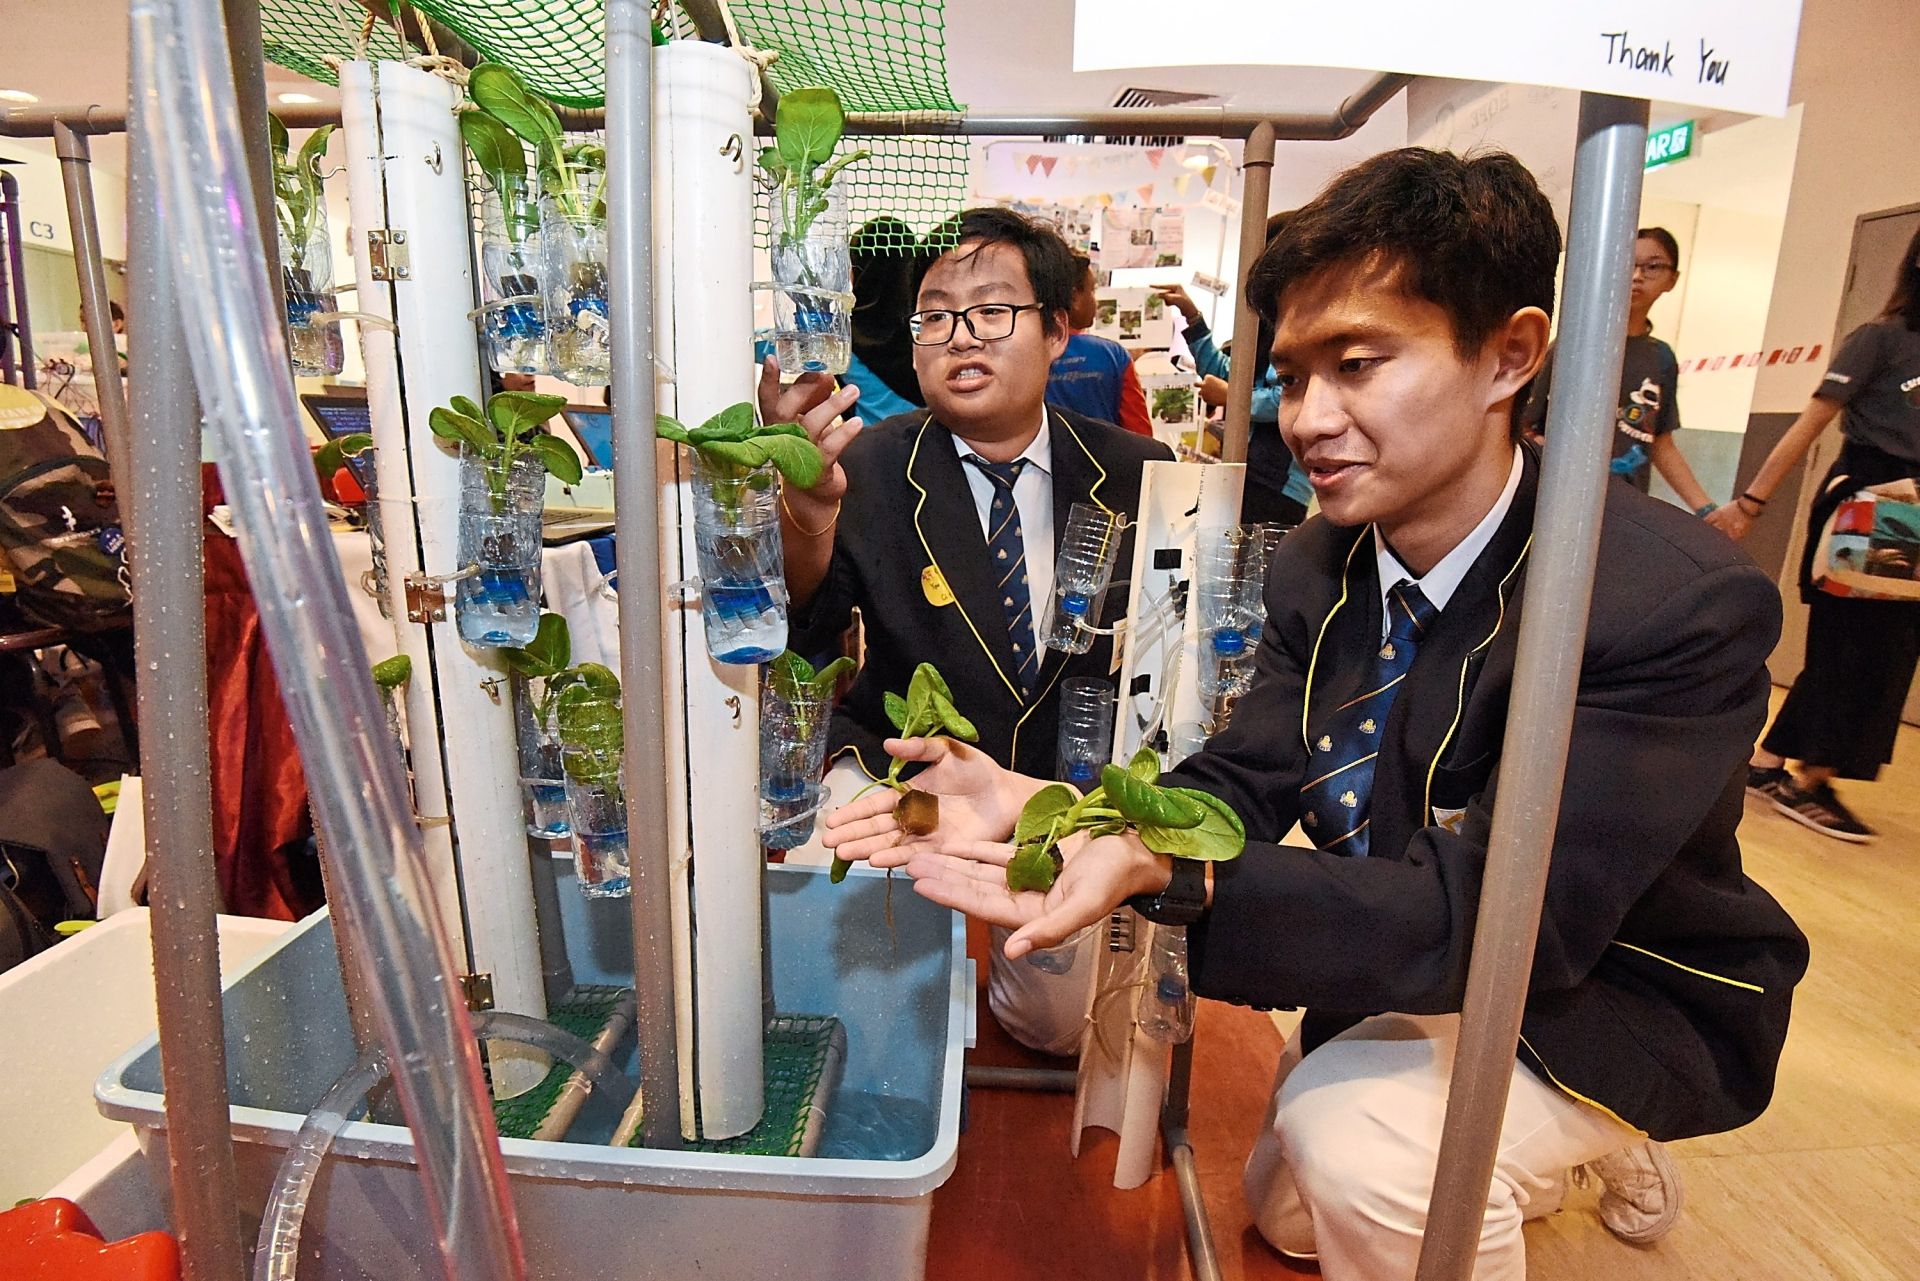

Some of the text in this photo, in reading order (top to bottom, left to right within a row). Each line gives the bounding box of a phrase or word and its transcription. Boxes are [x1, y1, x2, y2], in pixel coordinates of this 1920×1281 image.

[1600, 30, 1729, 85] Thank You
[1645, 133, 1669, 163] AR
[30, 221, 54, 240] C3
